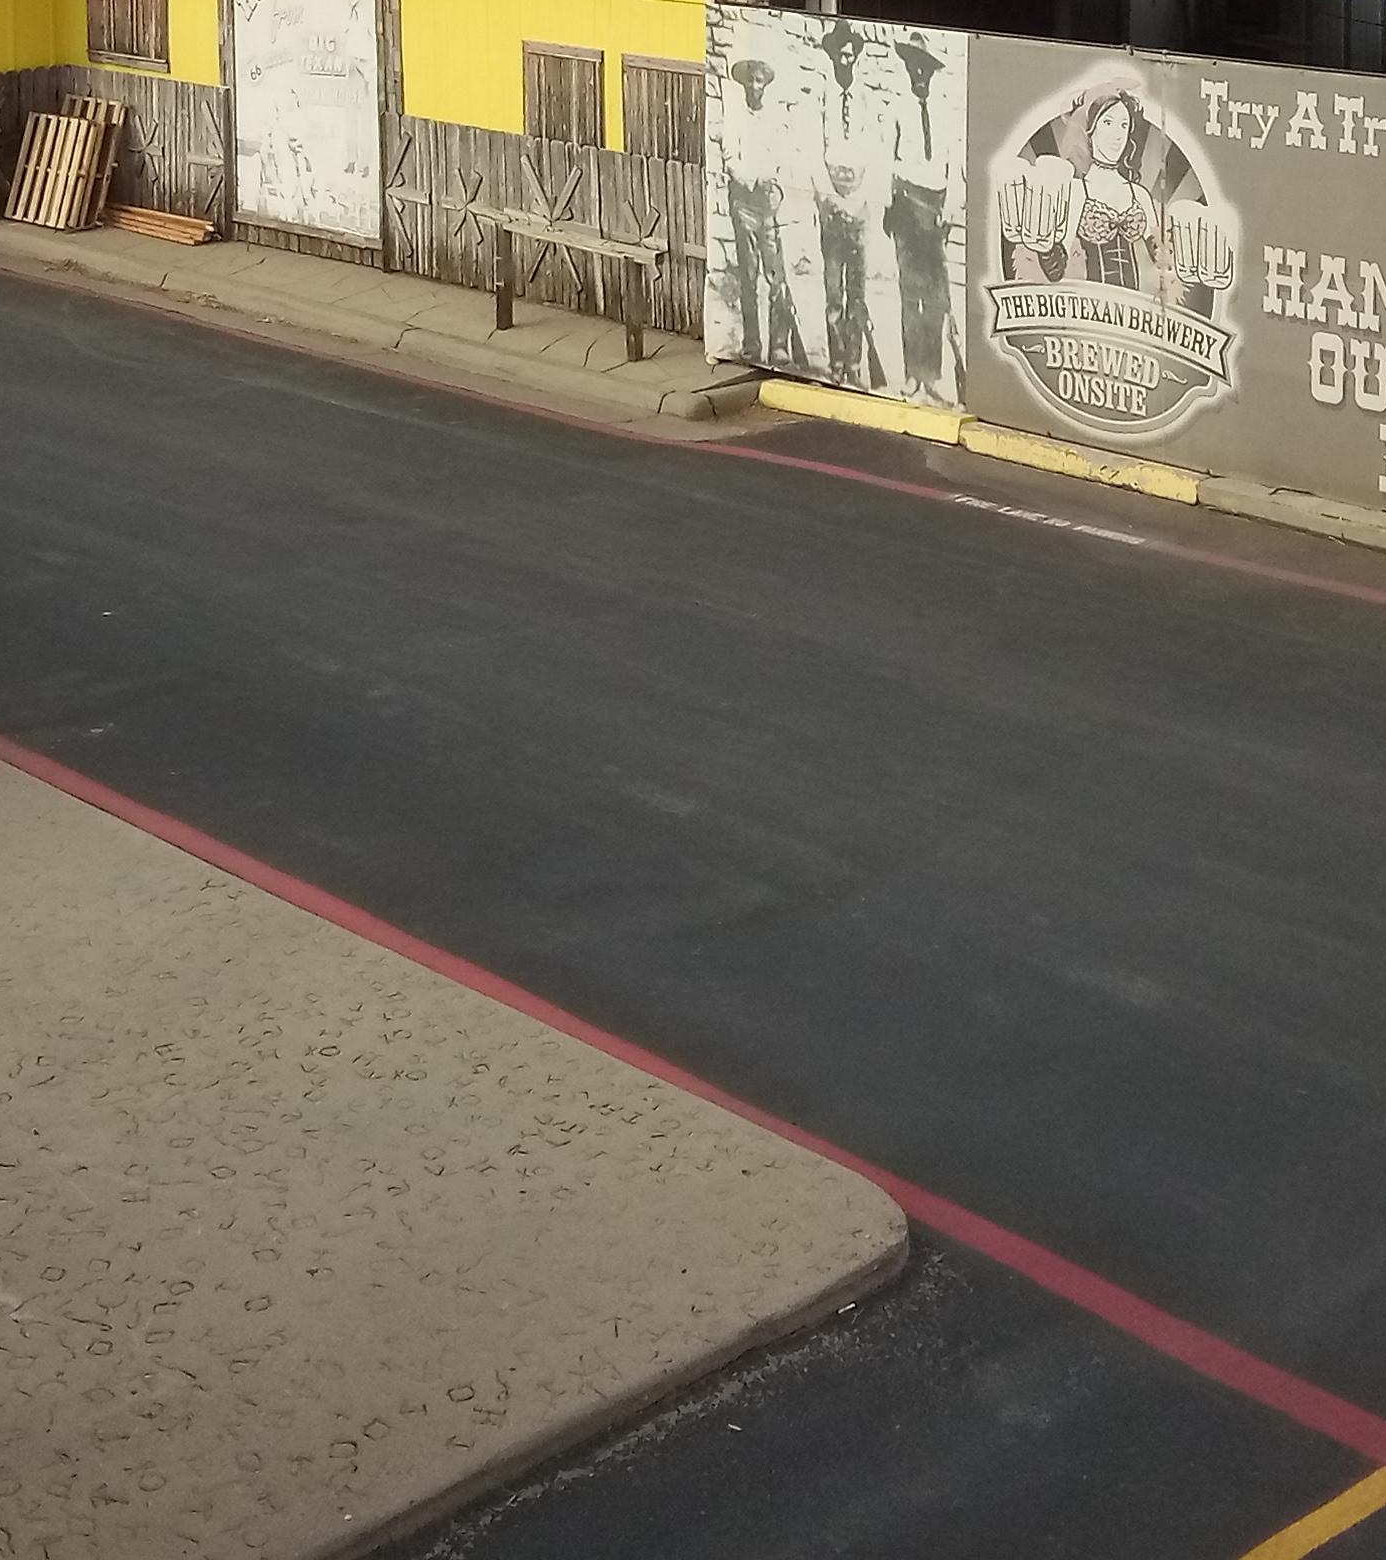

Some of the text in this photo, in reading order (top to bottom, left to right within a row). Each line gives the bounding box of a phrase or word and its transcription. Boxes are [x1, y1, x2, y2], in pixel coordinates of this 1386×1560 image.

[1199, 78, 1279, 149] Try
[1285, 91, 1327, 153] A
[1001, 295, 1218, 360] THE BIG TEXAN BREWERY
[1043, 335, 1162, 390] BREWED
[1058, 369, 1149, 417] ONSITE
